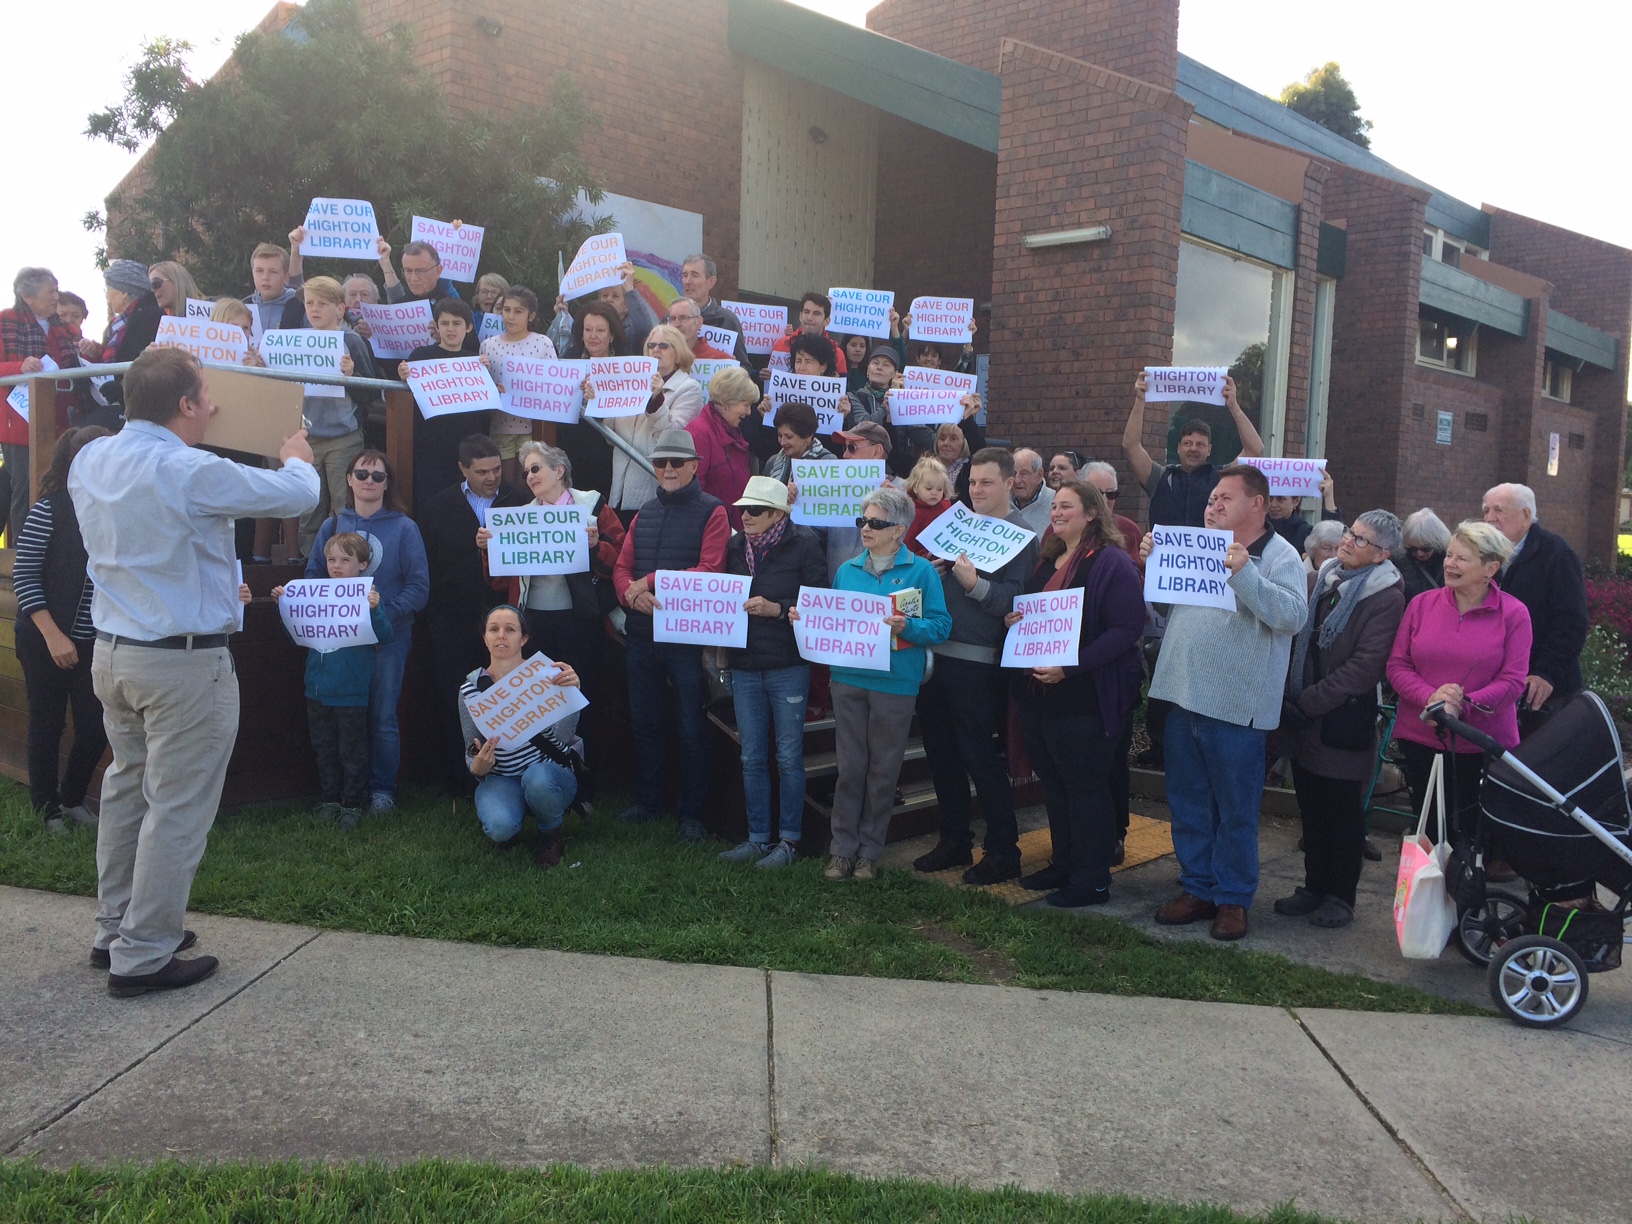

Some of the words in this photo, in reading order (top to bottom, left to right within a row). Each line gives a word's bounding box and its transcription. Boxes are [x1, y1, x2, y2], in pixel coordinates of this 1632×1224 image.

[308, 203, 338, 215] SAVE
[343, 204, 373, 217] OUR
[307, 219, 371, 233] HIGHTON
[417, 222, 454, 238] SAVE
[458, 229, 482, 243] OUR
[310, 236, 371, 250] LIBRARY
[590, 237, 618, 251] OUR
[567, 265, 618, 291] LIBRARY
[833, 290, 862, 301] SAVE
[866, 292, 890, 304] OUR
[188, 304, 211, 318] SAV
[362, 307, 392, 320] SAVE
[395, 306, 426, 320] OUR
[834, 302, 885, 317] HIGHTON
[914, 300, 942, 311] SAVE
[945, 301, 969, 312] OUR
[759, 309, 784, 320] OUR
[916, 313, 965, 324] HIGHTON
[371, 323, 428, 336] HIGHTON
[485, 318, 506, 331] SAV
[741, 321, 780, 334] GHTON
[834, 315, 882, 330] LIBRARY
[158, 322, 200, 338] SAVE
[205, 327, 242, 344] OUR
[704, 330, 731, 345] OUR
[917, 325, 964, 337] LIBRARY
[266, 335, 302, 347] SAVE
[306, 335, 338, 349] OUR
[268, 353, 335, 368] HIGHTON
[591, 362, 620, 375] SAVE
[623, 361, 652, 374] OUR
[409, 362, 450, 379] SAVE
[452, 361, 482, 373] OUR
[506, 360, 544, 376] SAVE
[548, 365, 580, 380] OUR
[1153, 371, 1217, 383] HIGHTON
[420, 376, 485, 392] HIGHTON
[596, 379, 648, 392] HIGHTON
[773, 375, 807, 390] SAVE
[811, 381, 841, 394] OUR
[907, 370, 940, 385] SAVE
[944, 376, 972, 389] OUR
[511, 378, 574, 397] HIGHTON
[897, 390, 957, 400] HIGHTON
[1155, 384, 1216, 396] LIBRARY
[428, 390, 489, 407] LIBRARY
[510, 395, 572, 414] LIBRARY
[597, 395, 645, 409] LIBRARY
[775, 392, 836, 410] HIGHTON
[898, 404, 954, 417] LIBRARY
[796, 465, 840, 479] SAVE
[845, 465, 880, 479] OUR
[801, 484, 876, 498] HIGHTON
[803, 503, 862, 516] LIBRAR
[492, 512, 538, 527] SAVE
[543, 510, 580, 524] OUR
[954, 508, 992, 531] SAVE
[992, 524, 1026, 544] OUR
[500, 530, 576, 545] HIGHTON
[945, 521, 1010, 555] HIGHTON
[1154, 531, 1192, 547] SAVE
[1197, 534, 1226, 553] OUR
[502, 550, 576, 565] LIBRARY
[1159, 553, 1226, 574] HIGHTON
[286, 584, 330, 598] SAVE
[334, 583, 366, 597] OUR
[660, 576, 703, 592] SAVE
[707, 578, 744, 594] OUR
[1157, 575, 1226, 596] LIBRARY
[289, 604, 361, 618] HIGHTON
[664, 597, 737, 614] HIGHTON
[801, 593, 846, 611] SAVE
[850, 598, 886, 616] OUR
[1016, 598, 1047, 616] SAVE
[1050, 595, 1079, 611] OUR
[293, 624, 359, 639] LIBRARY
[665, 618, 735, 635] LIBRARY
[804, 614, 880, 636] HIGHTON
[1017, 617, 1073, 636] HIGHTON
[804, 635, 877, 658] LIBRARY
[1014, 639, 1070, 657] LIBRARY
[468, 687, 511, 718] SAVE
[508, 660, 546, 688] OUR
[485, 675, 554, 731] HIGHTON
[502, 691, 568, 741] LIBRARY
